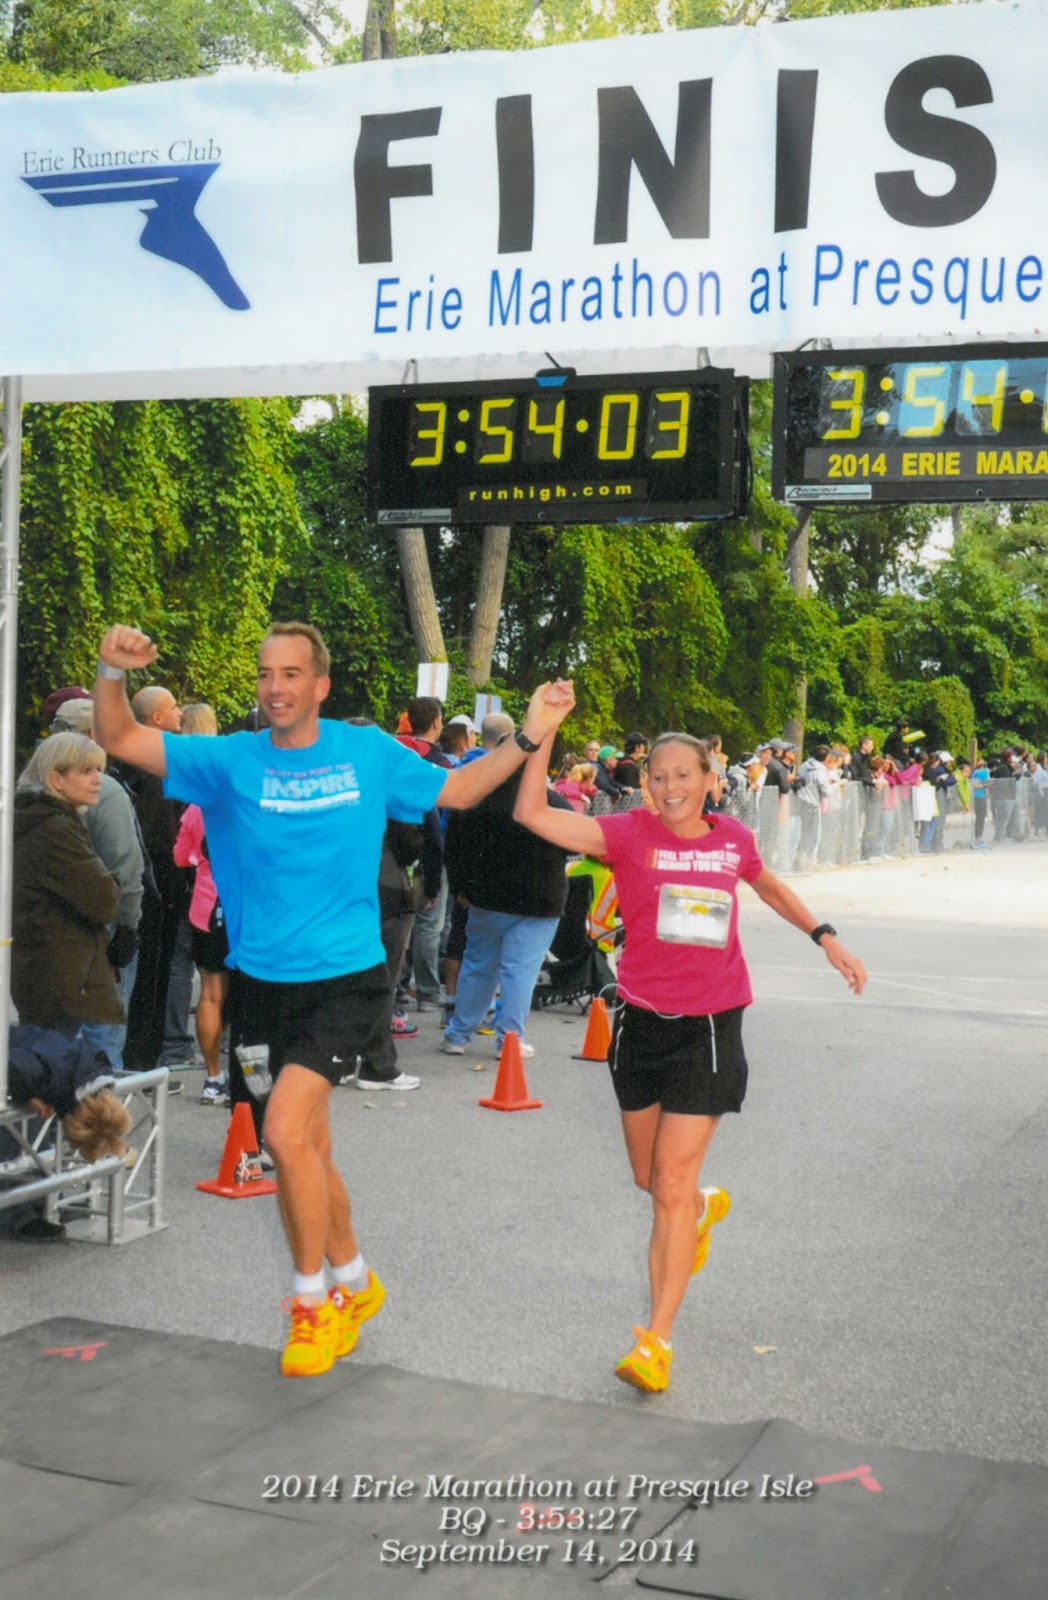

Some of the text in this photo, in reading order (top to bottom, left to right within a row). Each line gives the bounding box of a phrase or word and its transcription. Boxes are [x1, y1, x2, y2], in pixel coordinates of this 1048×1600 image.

[22, 138, 222, 175] Erie Runners Club
[373, 243, 1044, 335] Erie Marathon at Presque
[827, 449, 1048, 479] 2014 ERIE MARA
[468, 483, 634, 503] runhigh.com
[262, 769, 359, 800] INSPIRE
